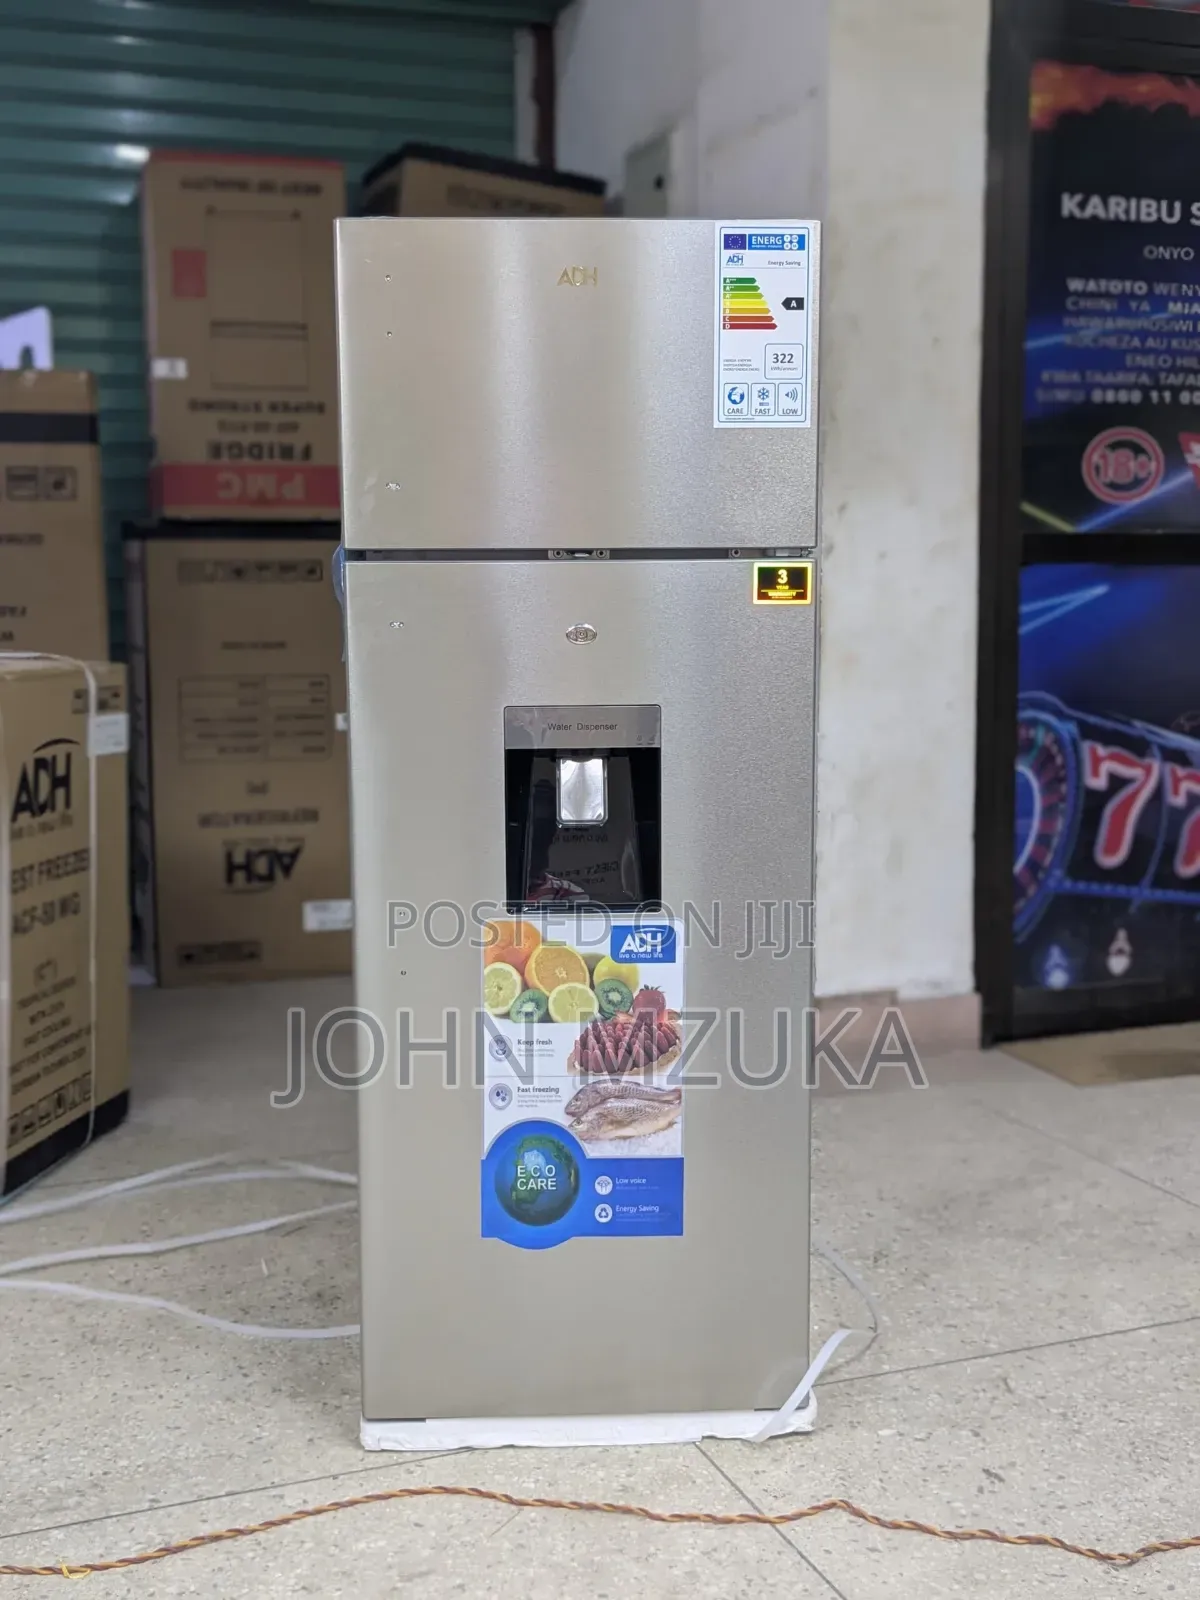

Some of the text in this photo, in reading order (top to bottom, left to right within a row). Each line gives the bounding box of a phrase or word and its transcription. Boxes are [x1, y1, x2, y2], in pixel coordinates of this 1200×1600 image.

[1061, 192, 1182, 224] KARIBU
[751, 235, 783, 245] ENERG
[727, 254, 744, 264] ADH
[1143, 245, 1195, 261] ONYO
[556, 265, 599, 288] ADH
[1066, 278, 1149, 295] WATOTO
[790, 300, 797, 308] A
[772, 353, 794, 364] 322
[216, 472, 307, 502] PMC
[777, 569, 788, 584] 3
[547, 722, 618, 732] Water Dispenser
[11, 752, 72, 822] ADH
[226, 847, 303, 886] ADH
[620, 932, 662, 953] ADH
[517, 1038, 553, 1047] Keep fresh
[532, 1086, 560, 1095] freezing
[517, 1164, 556, 1177] ECO
[516, 1178, 557, 1190] CARE
[615, 1204, 660, 1213] Energy Saving
